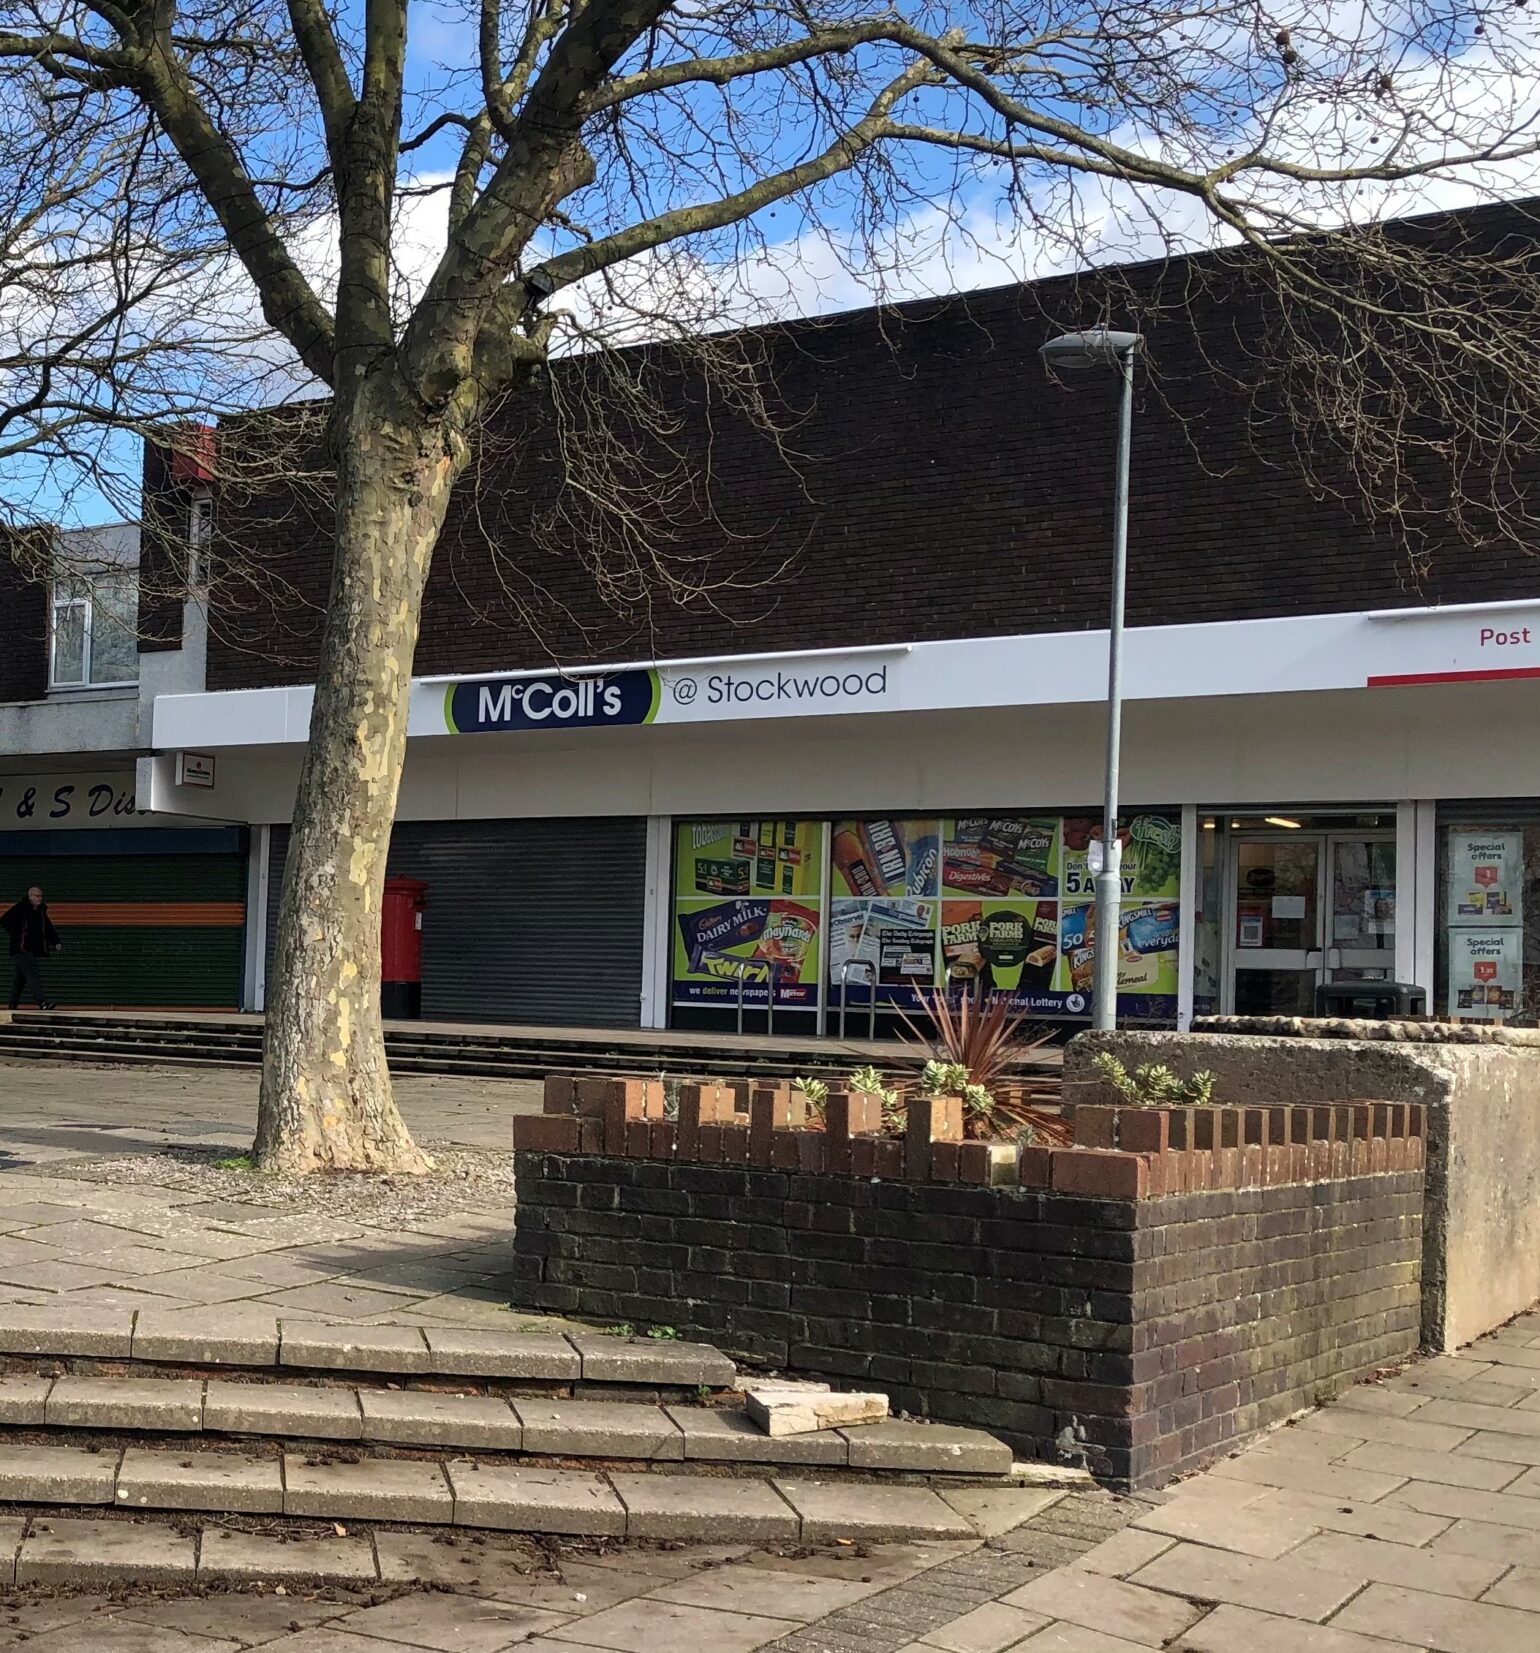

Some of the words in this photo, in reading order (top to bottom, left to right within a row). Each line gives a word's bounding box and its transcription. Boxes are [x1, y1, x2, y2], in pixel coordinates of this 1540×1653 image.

[1480, 627, 1531, 647] Post
[672, 677, 698, 705] @
[707, 666, 888, 704] Stockwood
[477, 679, 622, 723] McColl's
[16, 787, 36, 818] &
[49, 785, 75, 818] S
[1467, 843, 1506, 853] Special
[1471, 852, 1502, 861] offers
[948, 870, 992, 882] Digestives
[1066, 872, 1081, 894] 5
[696, 921, 734, 943] DAIRY
[733, 907, 766, 928] MILK
[942, 921, 981, 935] PORK
[989, 921, 1024, 931] PORK
[943, 932, 980, 946] FARM
[989, 930, 1023, 939] FARMS
[1063, 932, 1084, 950] 50
[1466, 938, 1505, 949] Special
[1470, 947, 1502, 956] offers
[1073, 949, 1095, 969] KINGS
[690, 988, 701, 996] we
[702, 986, 728, 996] deliver
[730, 987, 777, 998] newspapes
[991, 996, 1029, 1006] Nonal
[1031, 997, 1063, 1009] Lottery
